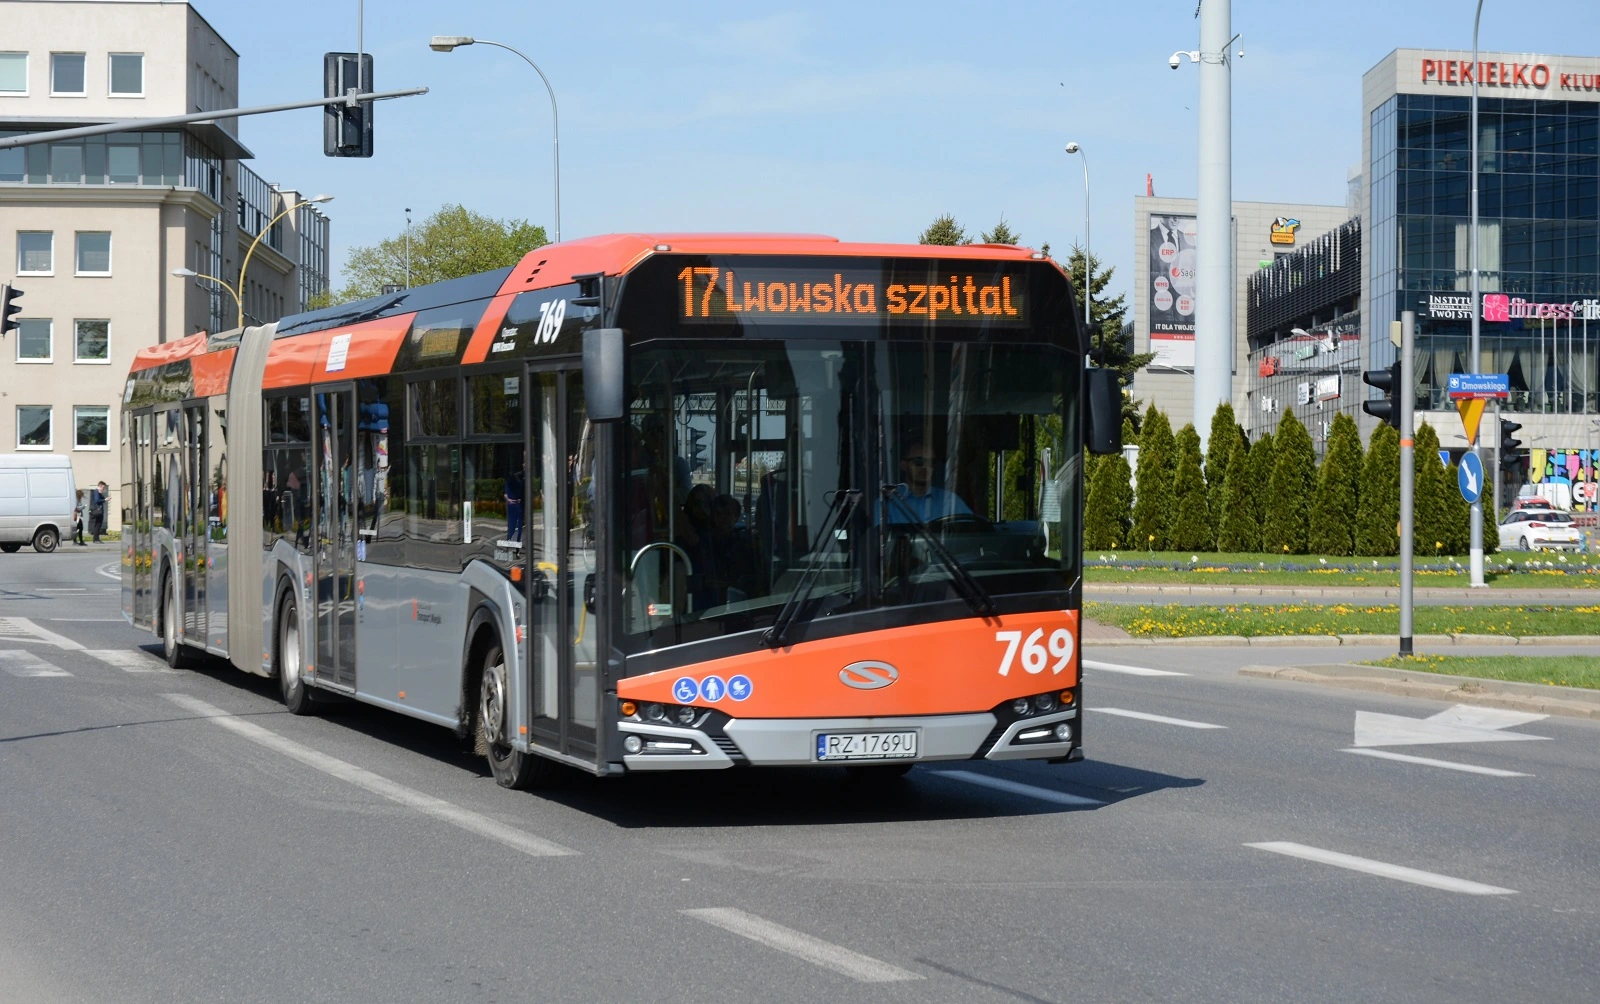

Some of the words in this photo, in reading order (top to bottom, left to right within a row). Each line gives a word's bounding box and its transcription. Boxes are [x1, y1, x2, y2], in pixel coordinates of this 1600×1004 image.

[1422, 59, 1550, 87] PIEKIEŁKO
[677, 266, 719, 317] 17
[725, 272, 876, 314] Lwowska
[886, 275, 1018, 320] szpital
[1429, 295, 1473, 304] INSTYTU
[1511, 297, 1574, 320] fitness
[534, 298, 566, 345] 769
[1461, 381, 1506, 391] Dmowskiego
[995, 627, 1074, 677] 769
[829, 736, 853, 753] RZ
[861, 734, 914, 753] 1769U
